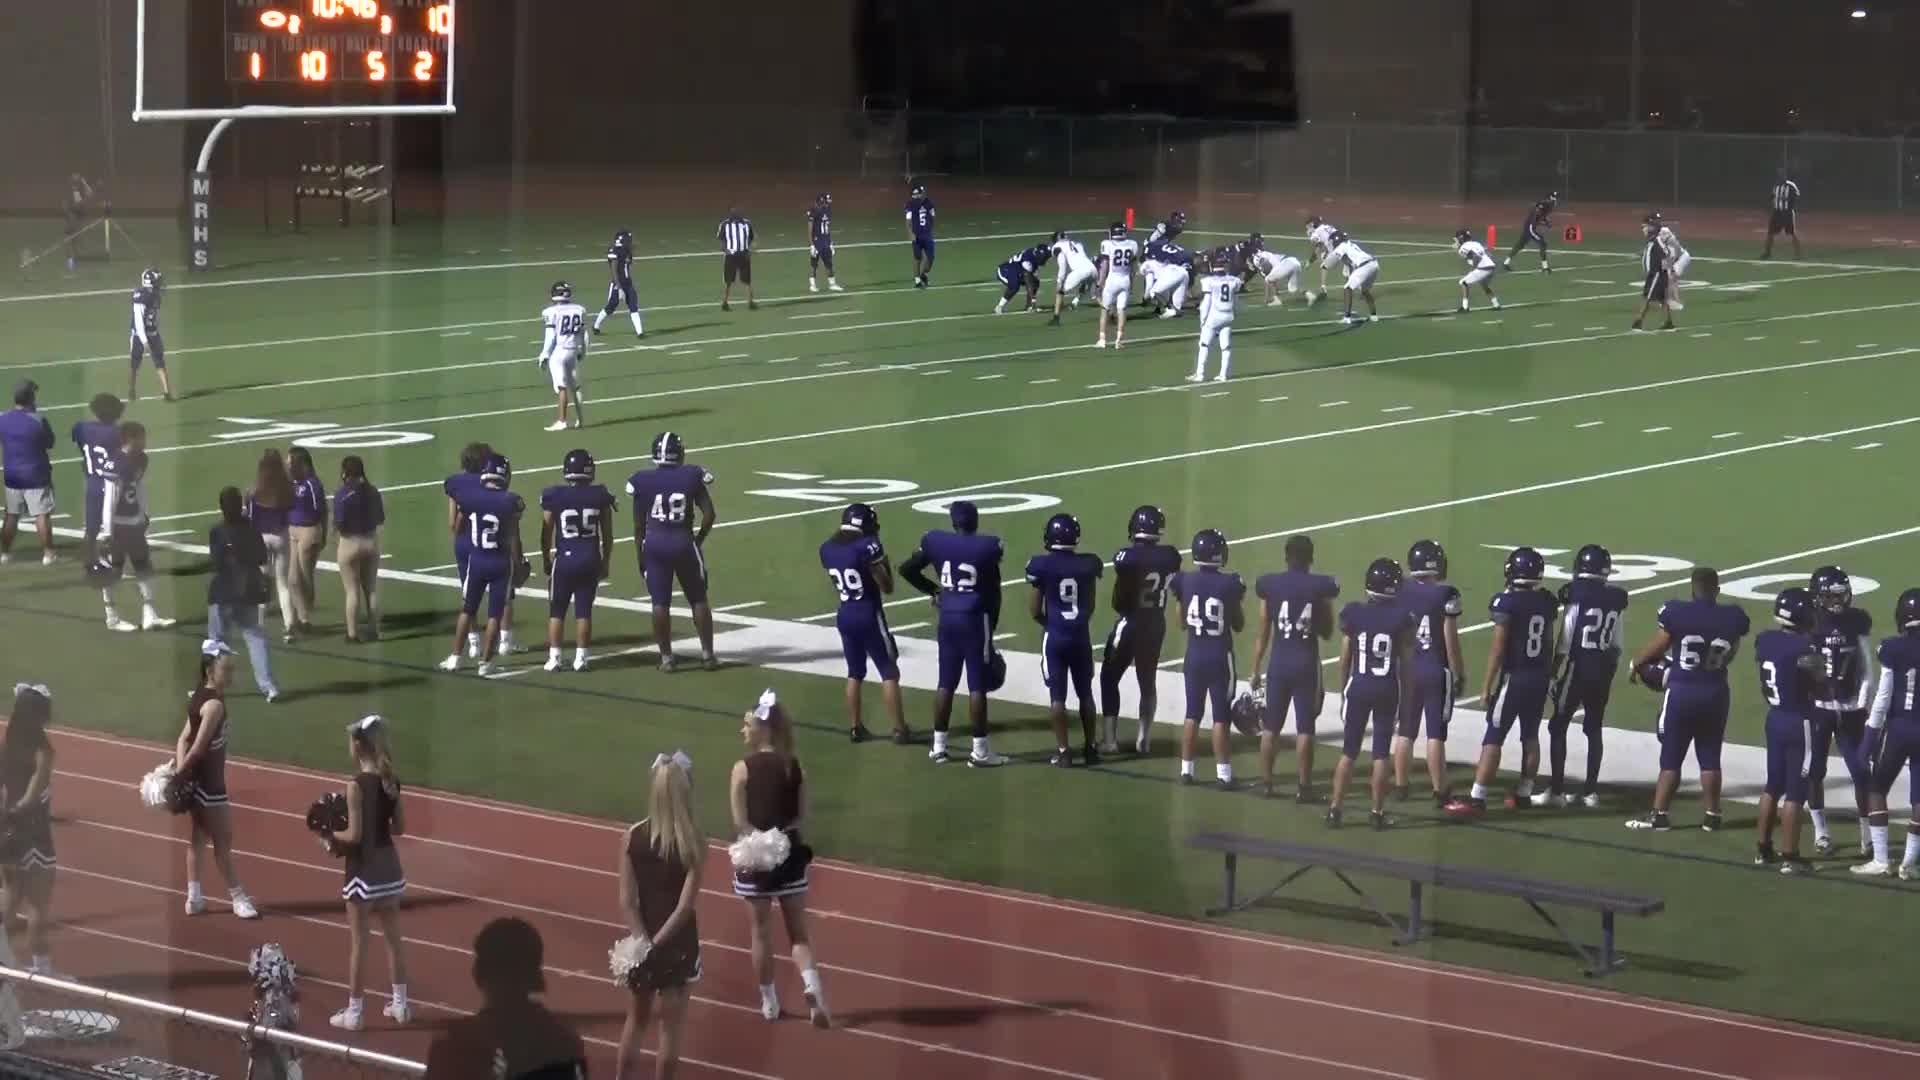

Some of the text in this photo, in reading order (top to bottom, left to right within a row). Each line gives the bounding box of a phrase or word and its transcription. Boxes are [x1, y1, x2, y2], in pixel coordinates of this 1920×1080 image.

[428, 5, 450, 34] 10
[251, 52, 260, 79] 1
[301, 51, 326, 80] 10
[367, 51, 385, 80] 5
[414, 51, 433, 80] 2
[193, 179, 209, 266] MRHS
[1113, 249, 1132, 267] 29
[560, 508, 601, 539] 65
[651, 493, 687, 521] 48
[469, 512, 500, 549] 12
[941, 560, 977, 592] 42
[1059, 577, 1079, 620] 9
[1186, 594, 1224, 636] 49
[1278, 600, 1312, 639] 44
[1526, 614, 1545, 658] 8
[1581, 607, 1618, 650] 20
[1358, 632, 1392, 676] 19
[1762, 660, 1781, 706] 3
